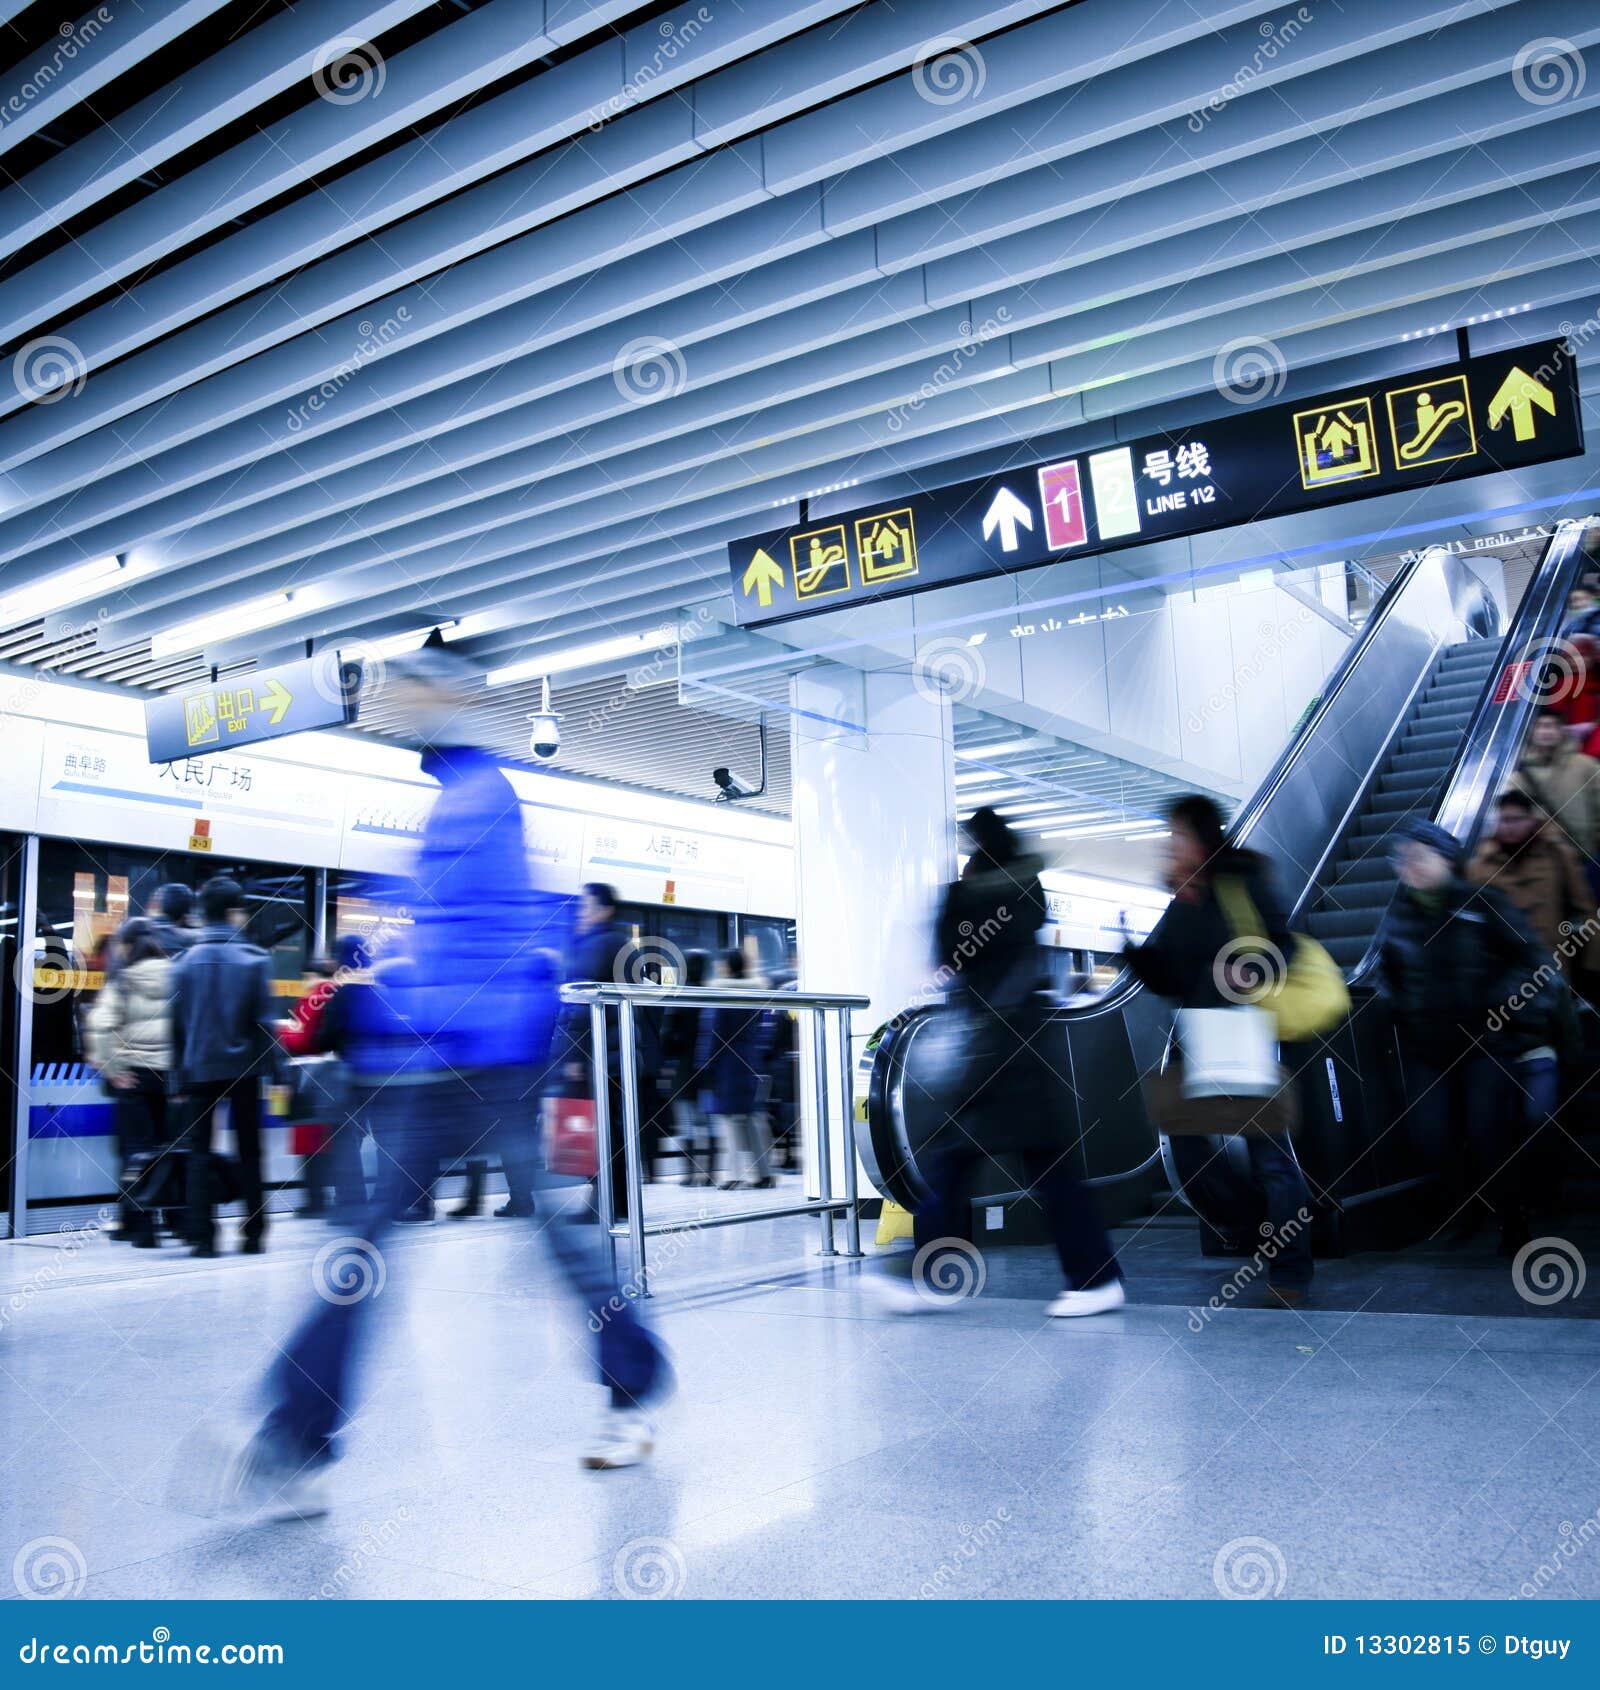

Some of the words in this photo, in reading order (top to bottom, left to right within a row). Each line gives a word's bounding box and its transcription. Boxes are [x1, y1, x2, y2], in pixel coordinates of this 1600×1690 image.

[1142, 442, 1212, 486] 号线
[1147, 491, 1187, 515] LINE
[217, 687, 255, 719] 出口
[227, 718, 248, 733] EXIT
[64, 753, 107, 774] 曲阜路
[160, 757, 252, 792] 人民广场
